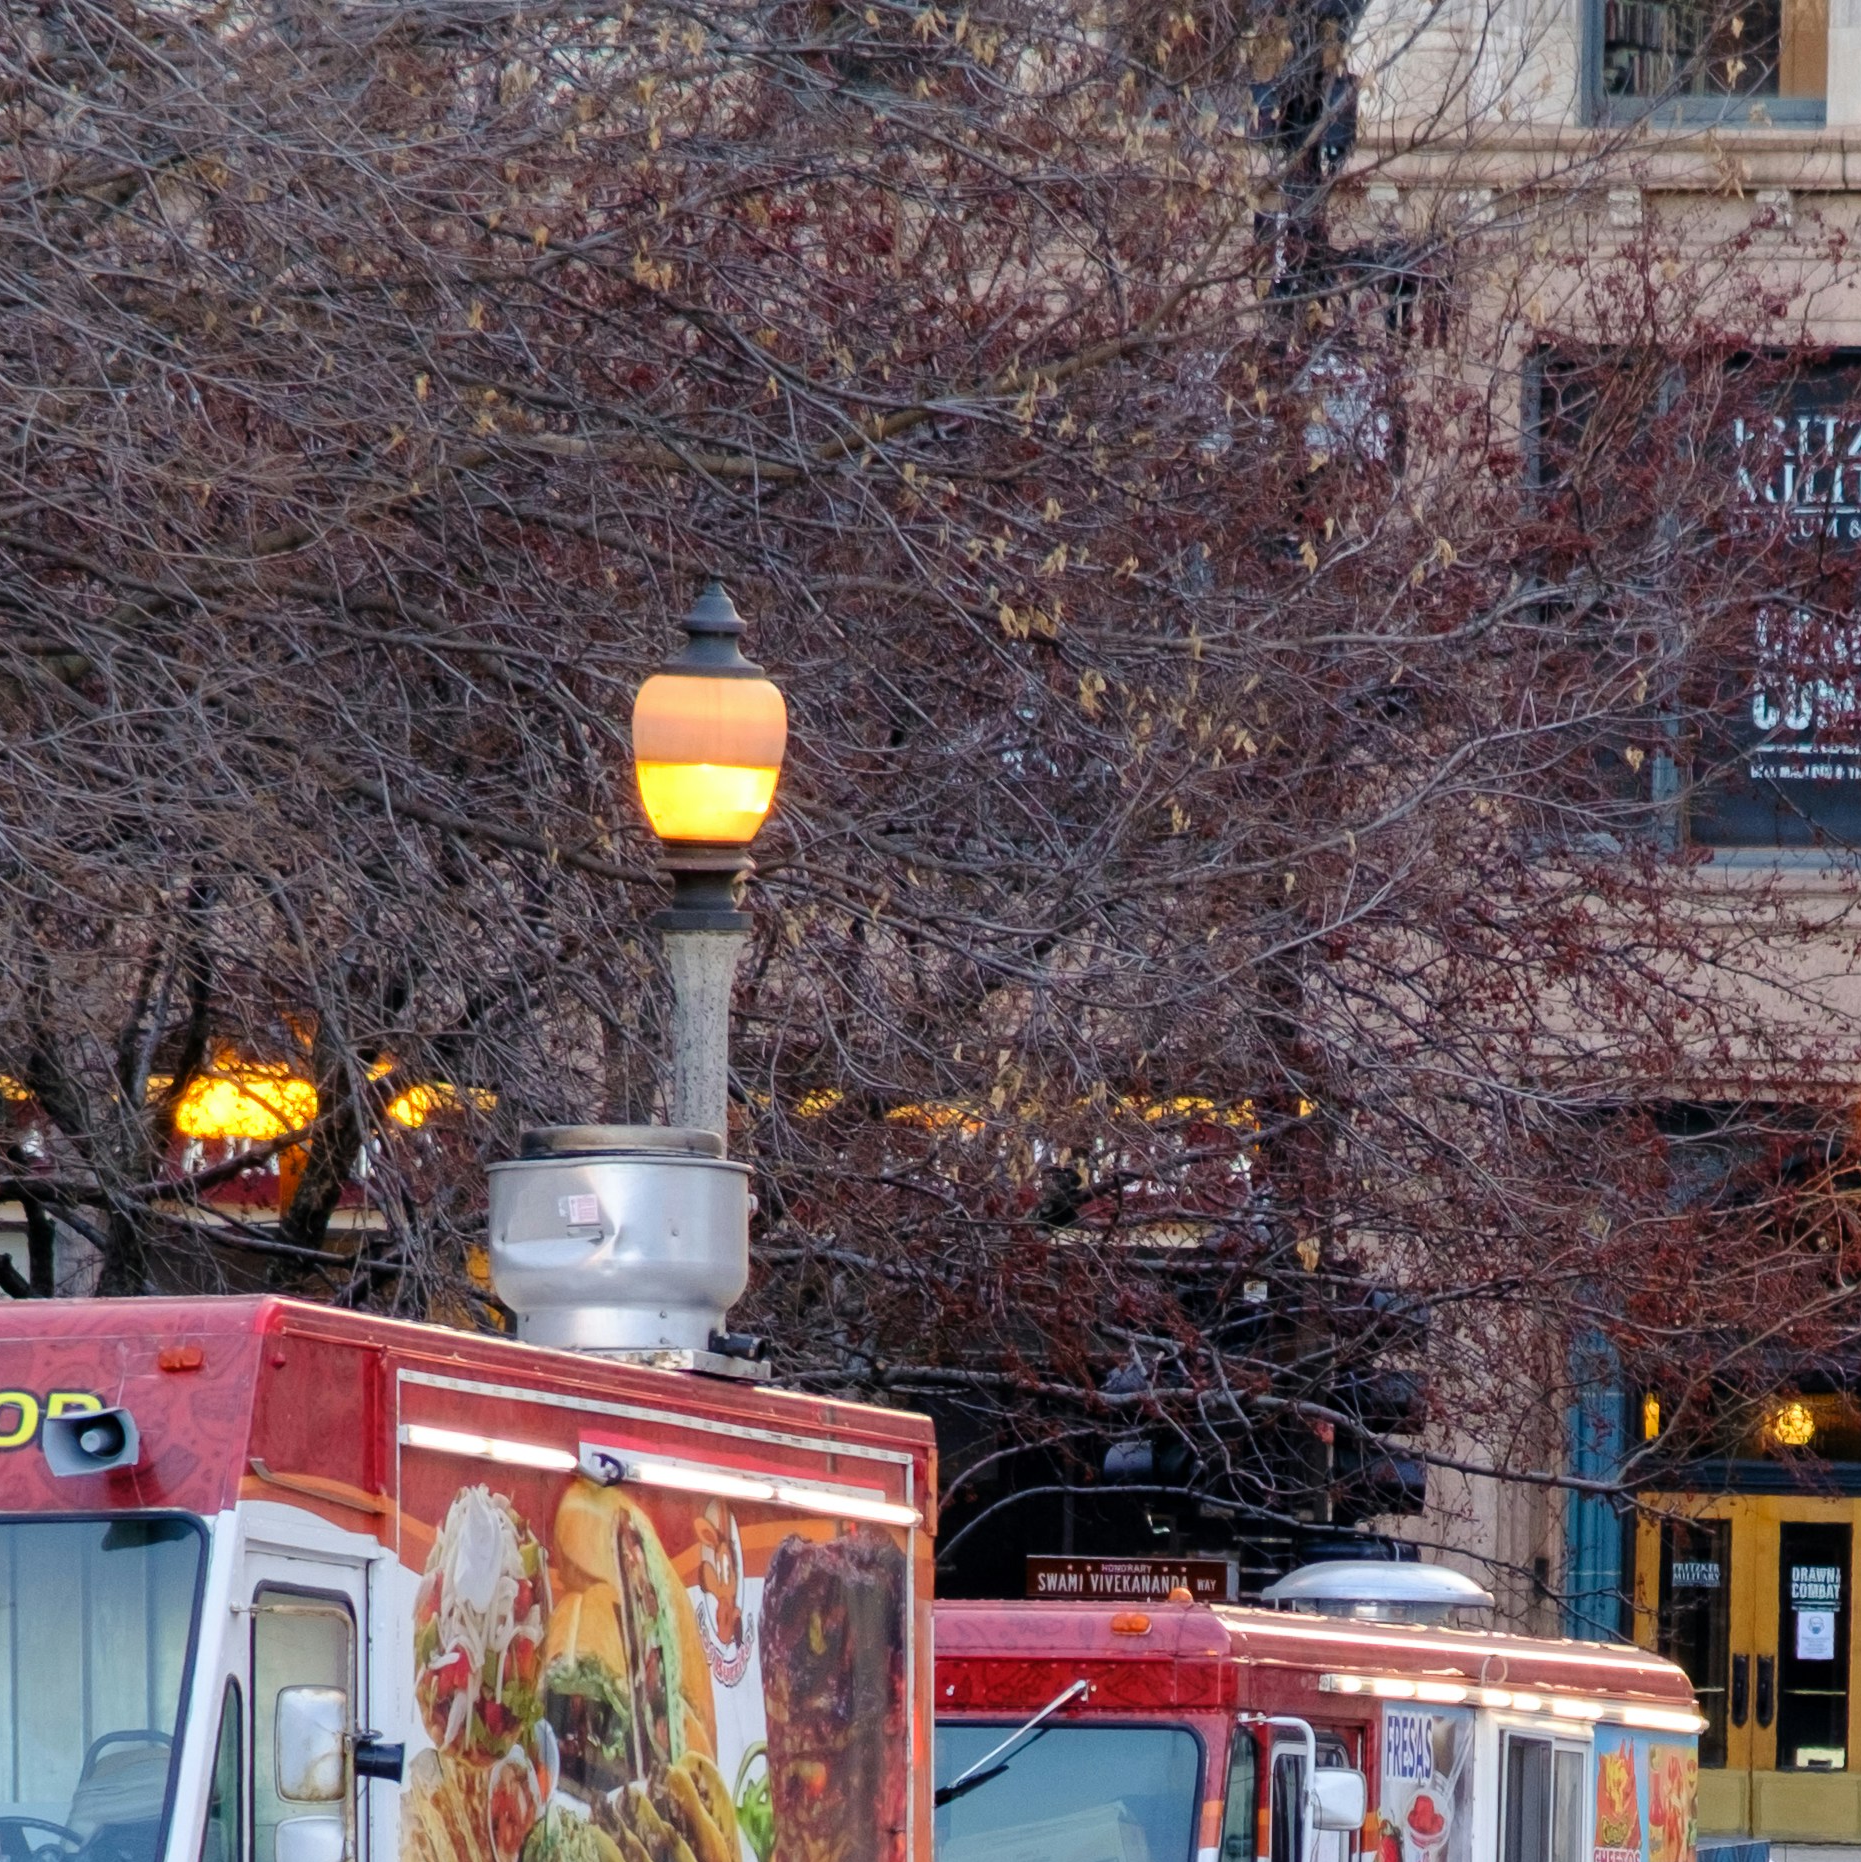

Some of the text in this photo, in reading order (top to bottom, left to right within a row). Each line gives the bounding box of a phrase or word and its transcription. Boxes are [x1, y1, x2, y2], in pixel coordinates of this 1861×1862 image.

[1037, 1572, 1218, 1594] SWAMI VIVEKANANDA WAY
[1791, 1566, 1834, 1583] DRAWN
[1791, 1583, 1842, 1600] COMBAT
[1386, 1713, 1434, 1781] FRESAS
